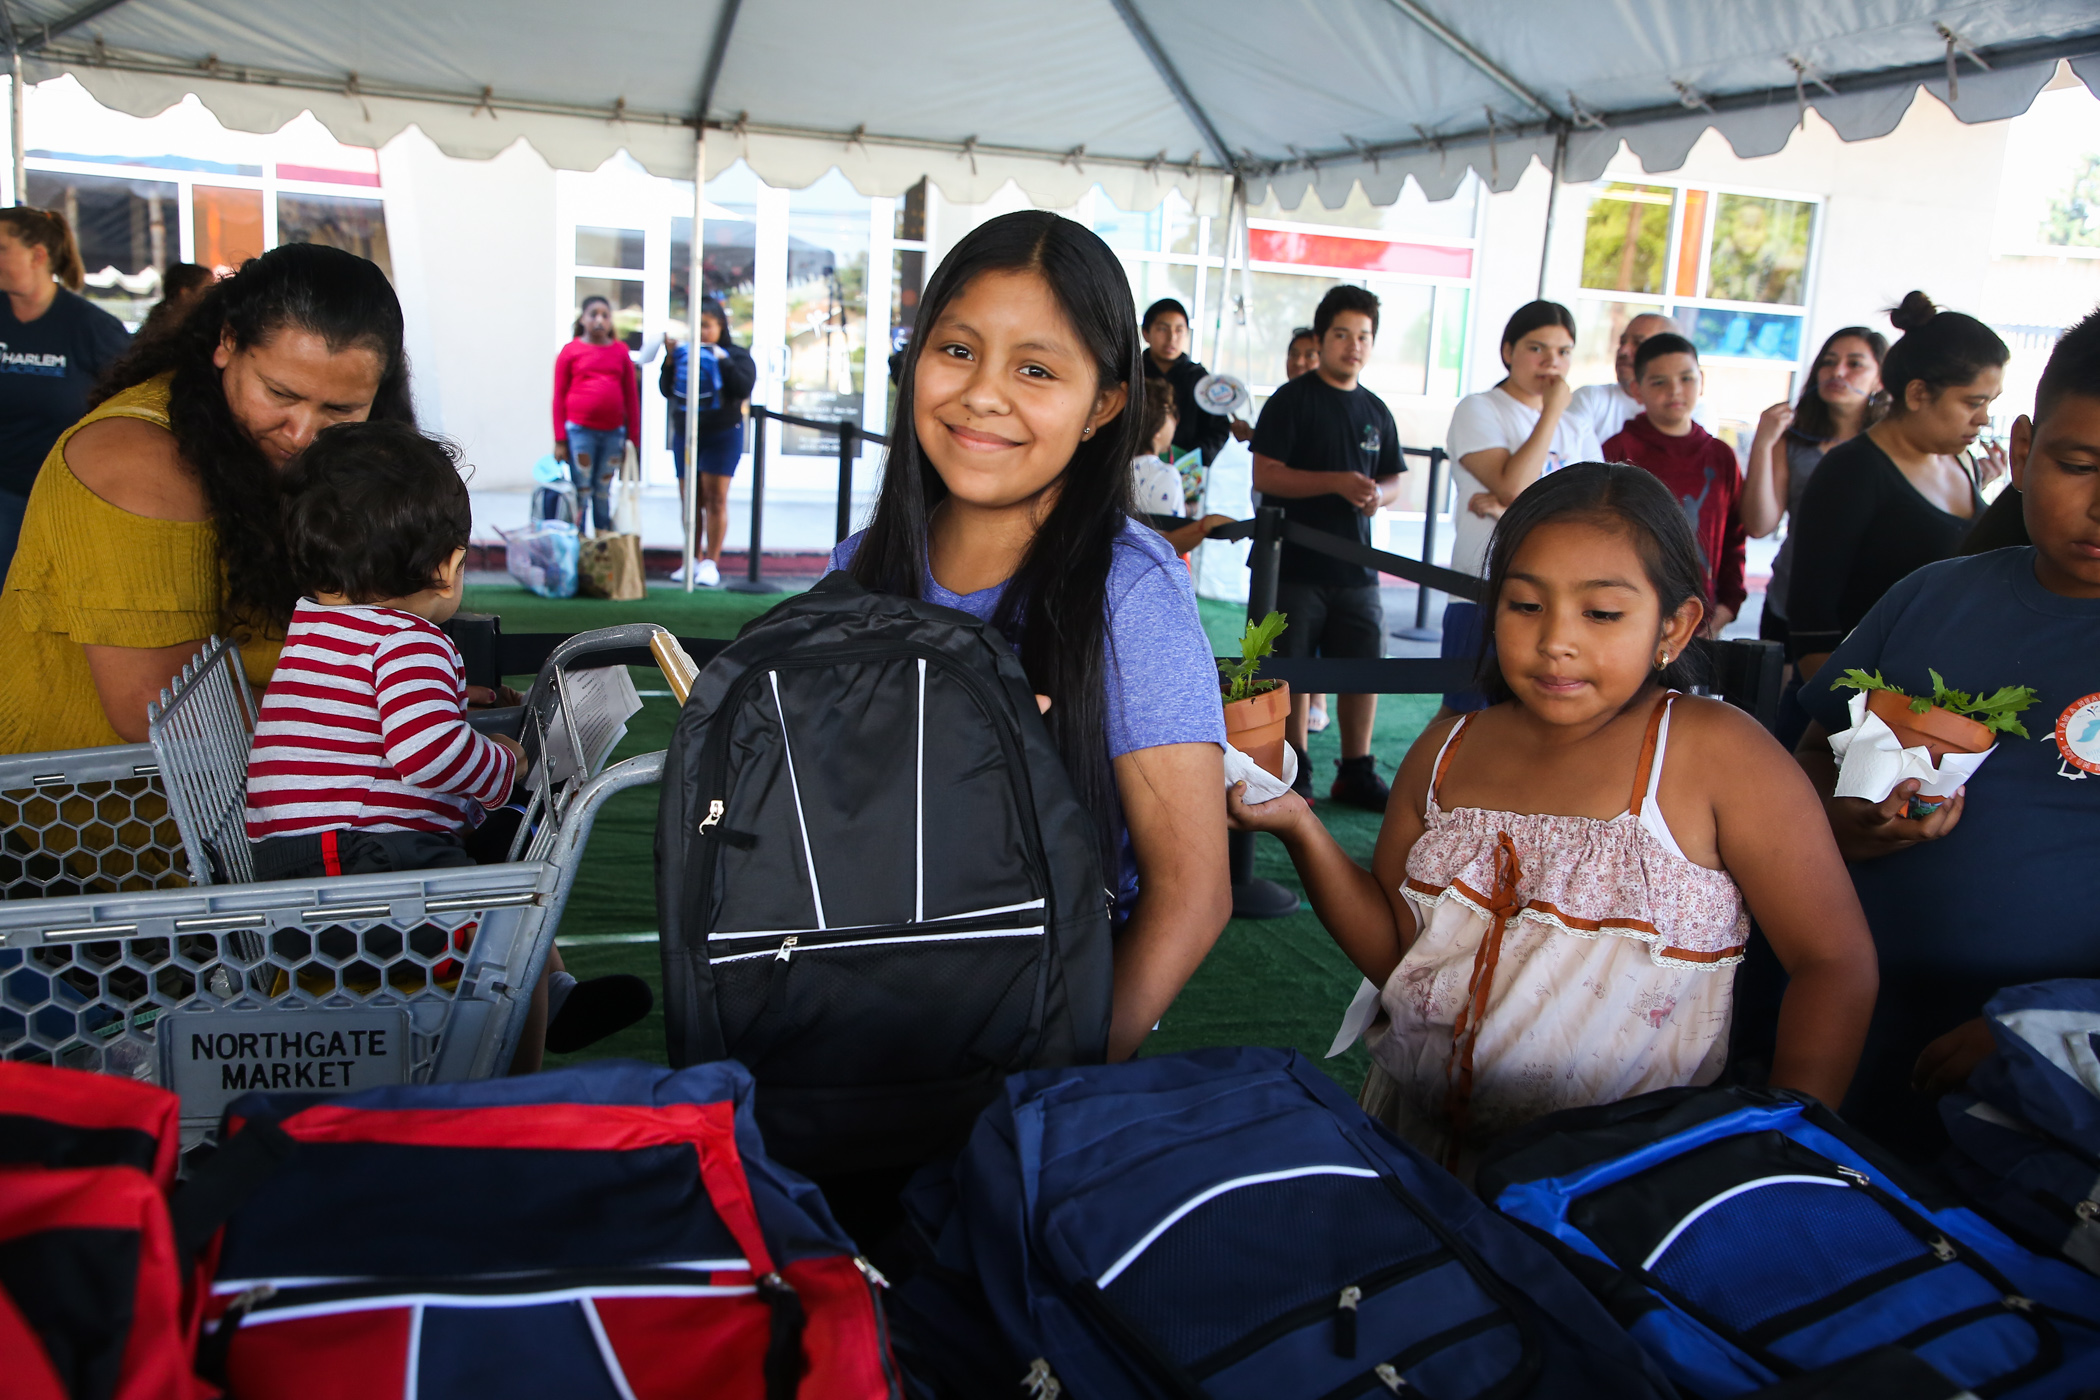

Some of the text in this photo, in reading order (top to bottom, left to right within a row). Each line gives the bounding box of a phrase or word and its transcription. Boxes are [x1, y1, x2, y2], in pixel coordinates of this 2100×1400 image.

[2, 352, 66, 367] HARLEM
[2077, 694, 2100, 708] HEA
[192, 1030, 387, 1060] NORTHGATE
[222, 1061, 355, 1090] MARKET
